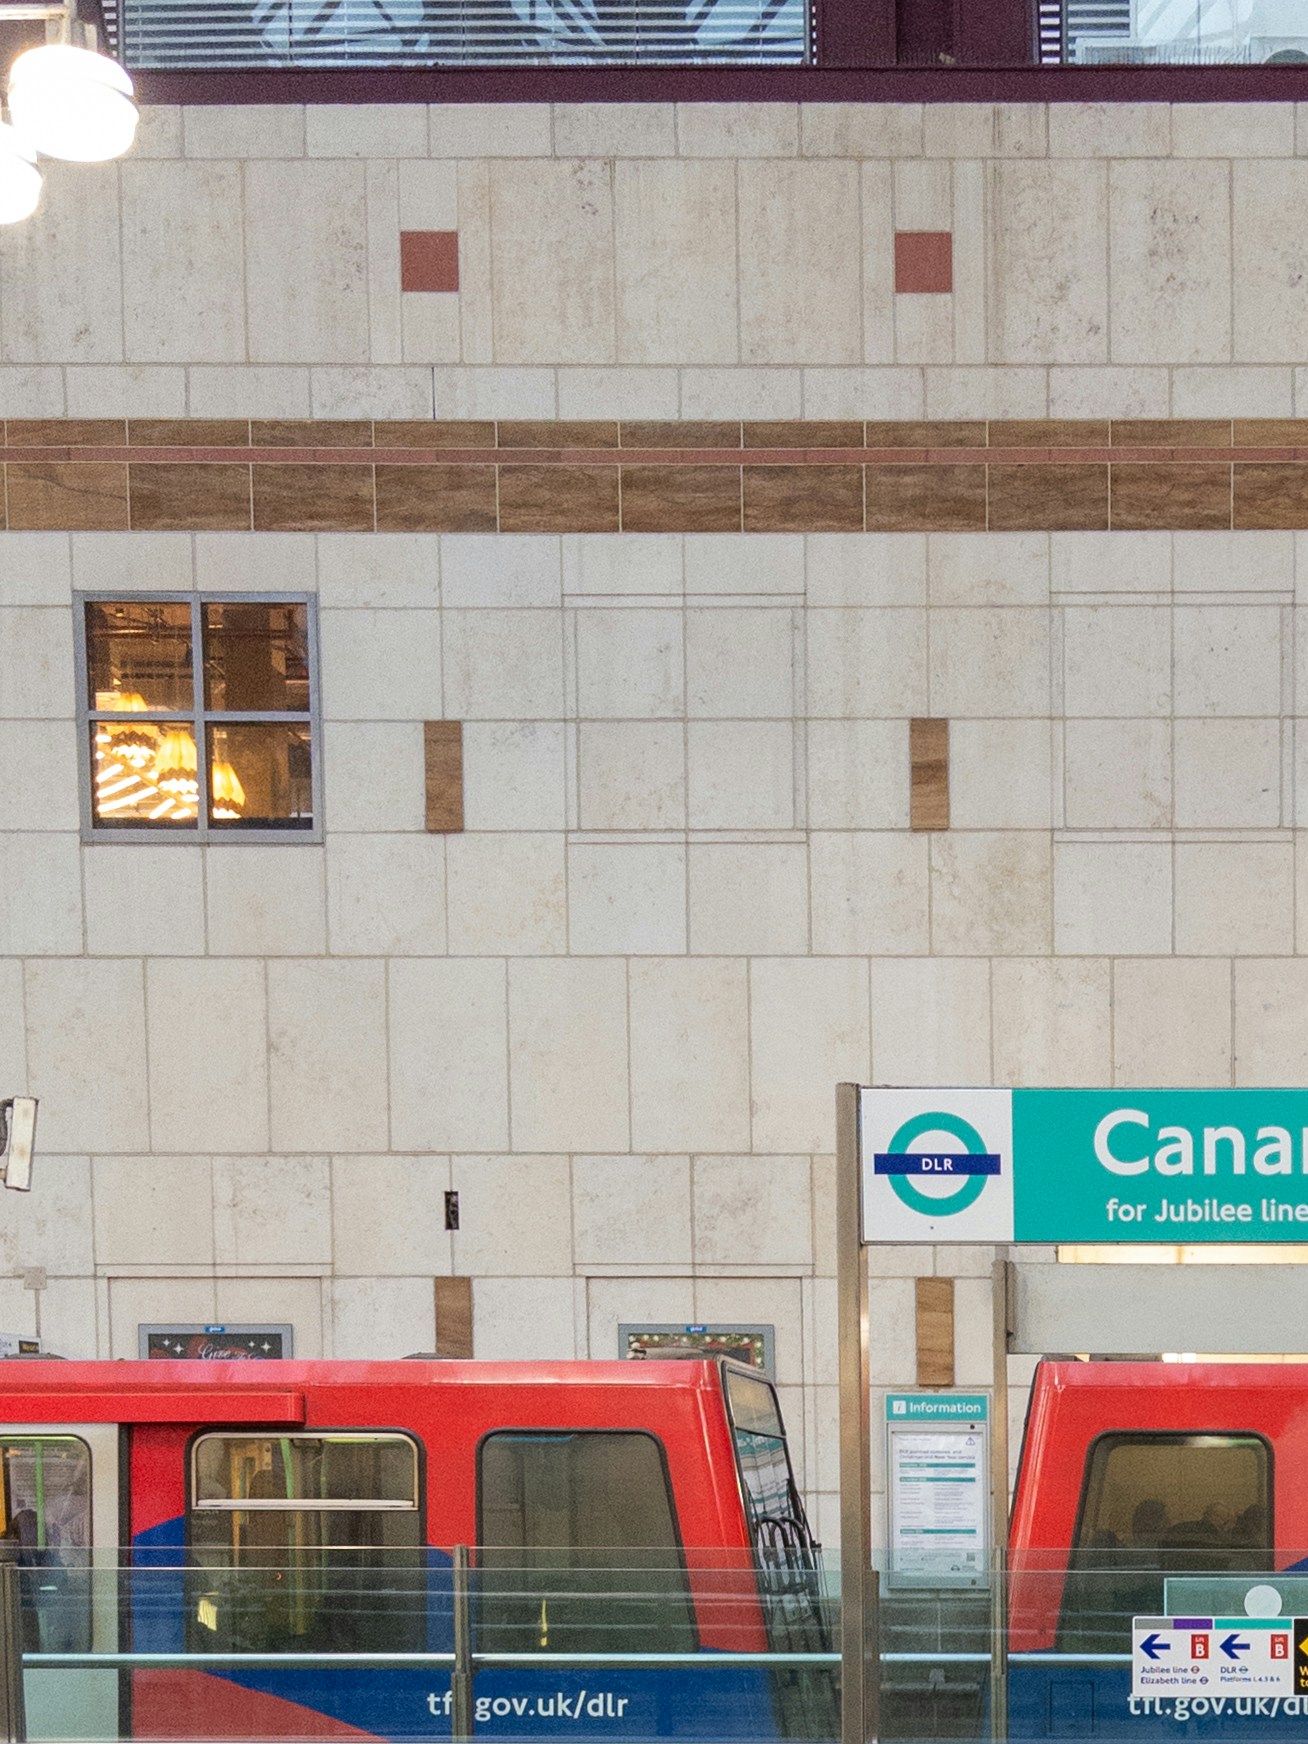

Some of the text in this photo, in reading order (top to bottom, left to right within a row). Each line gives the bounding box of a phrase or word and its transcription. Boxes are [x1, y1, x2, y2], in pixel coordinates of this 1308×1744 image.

[921, 1157, 954, 1171] DLR
[1106, 1197, 1147, 1222] for
[1154, 1198, 1253, 1223] Jubilee
[909, 1401, 982, 1414] Information
[1195, 1644, 1205, 1657] B
[1275, 1644, 1285, 1657] B
[1140, 1666, 1188, 1674] Jubilee line
[1220, 1666, 1237, 1674] DLR
[1140, 1676, 1197, 1685] Elizabeth line
[427, 1690, 629, 1722] tfgov.uk/dlr
